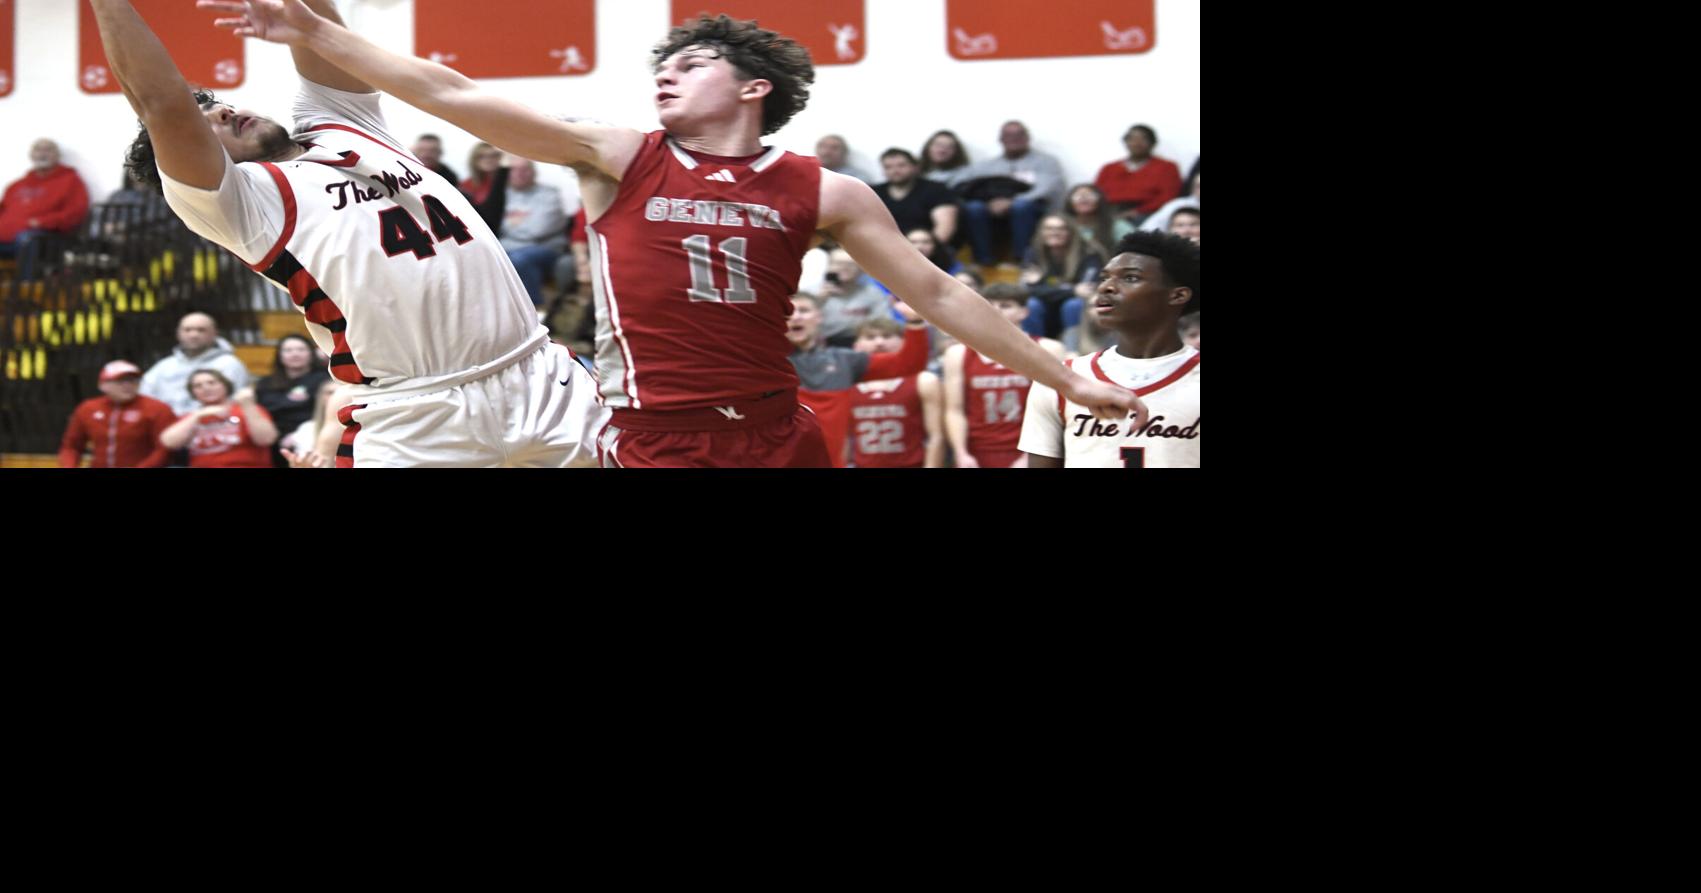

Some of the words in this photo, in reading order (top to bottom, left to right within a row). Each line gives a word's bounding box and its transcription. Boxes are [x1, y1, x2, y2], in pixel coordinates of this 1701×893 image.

[325, 180, 384, 210] The
[378, 194, 474, 261] 44
[682, 234, 757, 303] 11
[857, 419, 906, 454] 22
[1073, 413, 1120, 437] The
